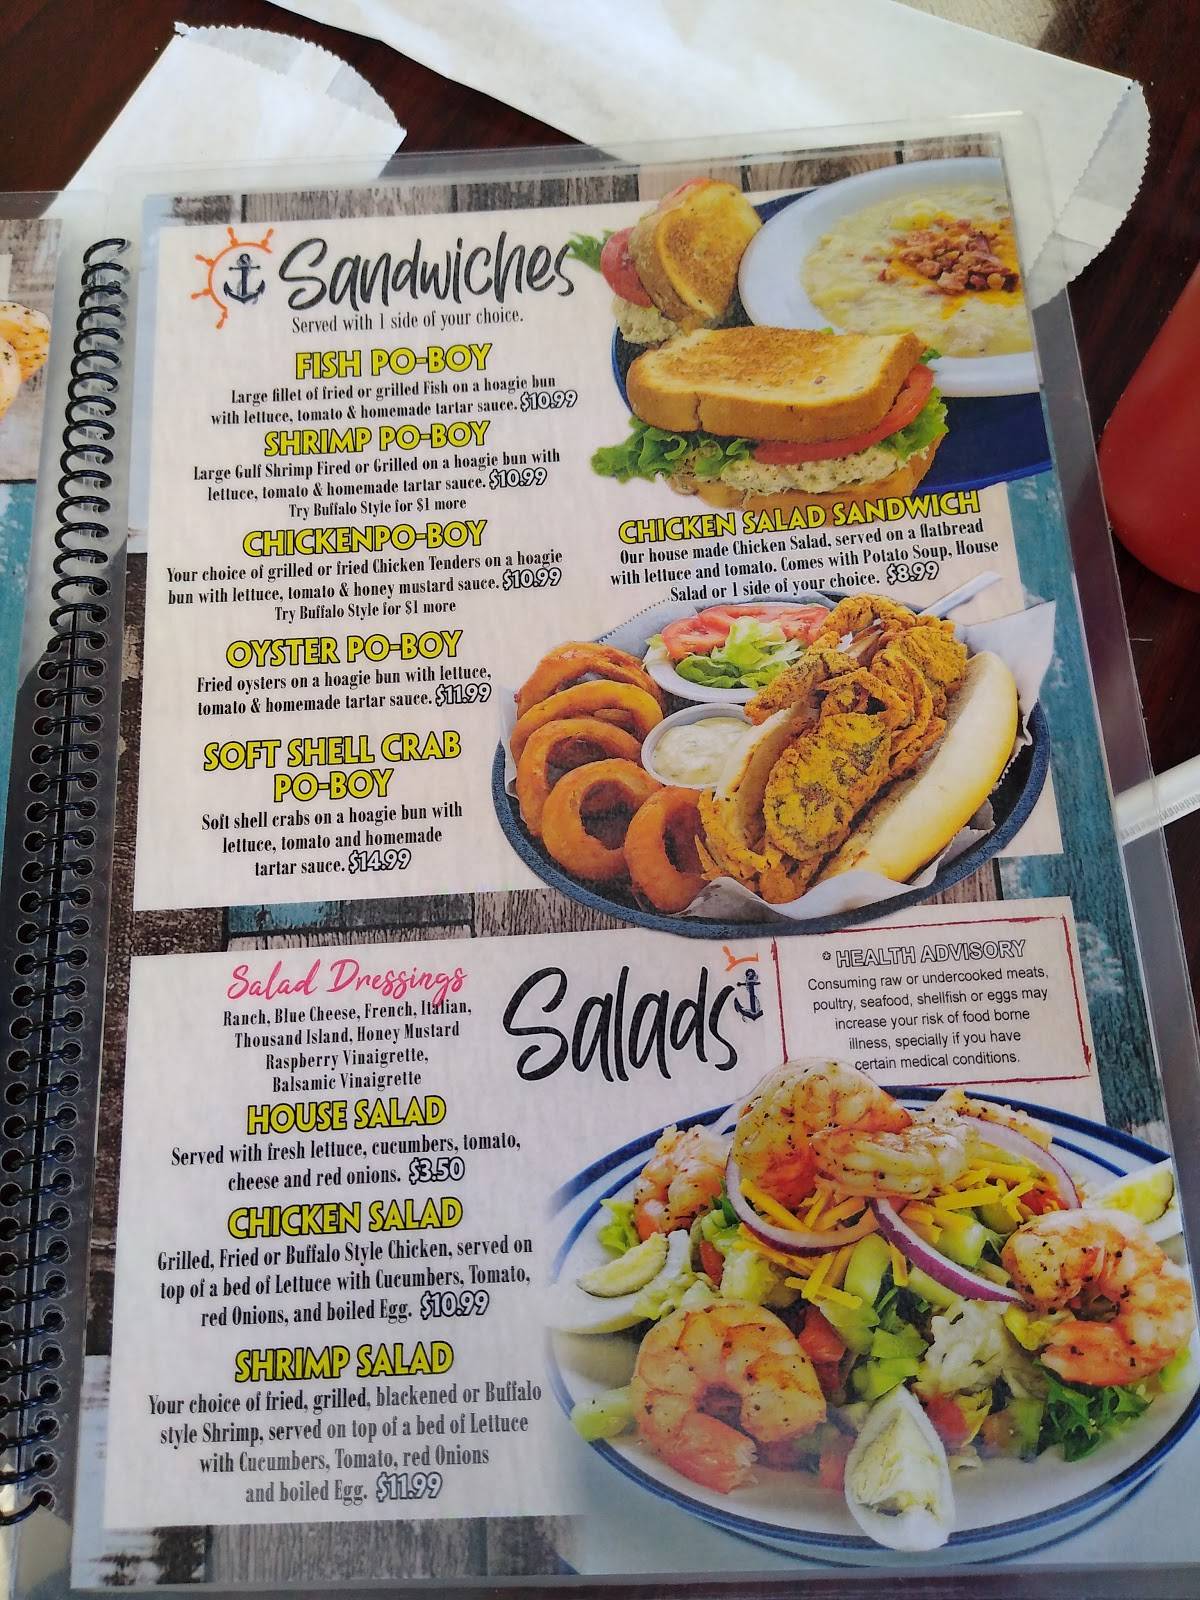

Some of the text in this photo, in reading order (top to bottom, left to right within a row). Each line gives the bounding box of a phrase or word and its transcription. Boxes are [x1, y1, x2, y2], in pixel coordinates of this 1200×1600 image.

[279, 231, 575, 311] Sandwiches
[291, 307, 524, 334] Served with 1 side of your choice.
[296, 343, 493, 380] FISH PO-BOY
[210, 390, 579, 425] with lettuce, tomato & homemade tartar sauce. $10.99
[264, 420, 491, 457] SHRIMP PO-BOY
[488, 467, 549, 491] $10.99
[288, 497, 467, 521] Try Buffalo Style for $1 more
[618, 489, 981, 544] CHICKEN SALAD SANDWICH
[242, 520, 488, 557] CHICKENPO-BOY
[619, 518, 985, 565] Our house made Chicken Salad, served on a flatbread
[166, 551, 563, 583] Your choice of grilled or fried Chicken Tenders on a hoagie
[501, 567, 563, 592] $10.99
[670, 559, 940, 603] Salad or 1 side of your choice. $8.99
[226, 630, 463, 668] OYSTER PO-BOY
[434, 682, 493, 708] $11.99
[204, 730, 462, 772] SOFT SHELL CRAB
[274, 768, 394, 803] PO-BOY
[221, 825, 443, 855] lettuce, tomato and homemade
[254, 848, 413, 877] tartar sauce. $14.99
[835, 938, 1027, 969] HEALTH ADVISORY
[228, 959, 468, 1007] Salad Dressings
[807, 965, 1049, 991] Consuming raw or undercooked meats,
[222, 1001, 472, 1028] Ranch, Blue Cheese, French, Italian,
[812, 988, 1048, 1014] poultry, seafood, shellfish or eggs may
[234, 1021, 460, 1049] Thousand Island, Honey Mustard
[503, 966, 739, 1081] Salads
[834, 1008, 1031, 1031] increase your risk of food borne
[848, 1029, 1022, 1051] illness, specially if you have
[854, 1051, 1021, 1072] certain medical conditions.
[272, 1070, 422, 1093] Balsamic Vinaigrette
[247, 1095, 446, 1135] HOUSE SALAD
[171, 1133, 521, 1167] Served with fresh lettuce, cucumbers, tomato,
[227, 1157, 466, 1192] cheese and red onions. $3.50
[228, 1197, 463, 1239] CHICKEN SALAD
[200, 1290, 491, 1327] red Onions, and boiled Egg. $10.99
[235, 1341, 454, 1382] SHRIMP SALAD
[148, 1382, 542, 1415] Your choice of fried, grilled, blackened or Buffalo
[245, 1472, 444, 1503] and boiled Egg. $11.99
